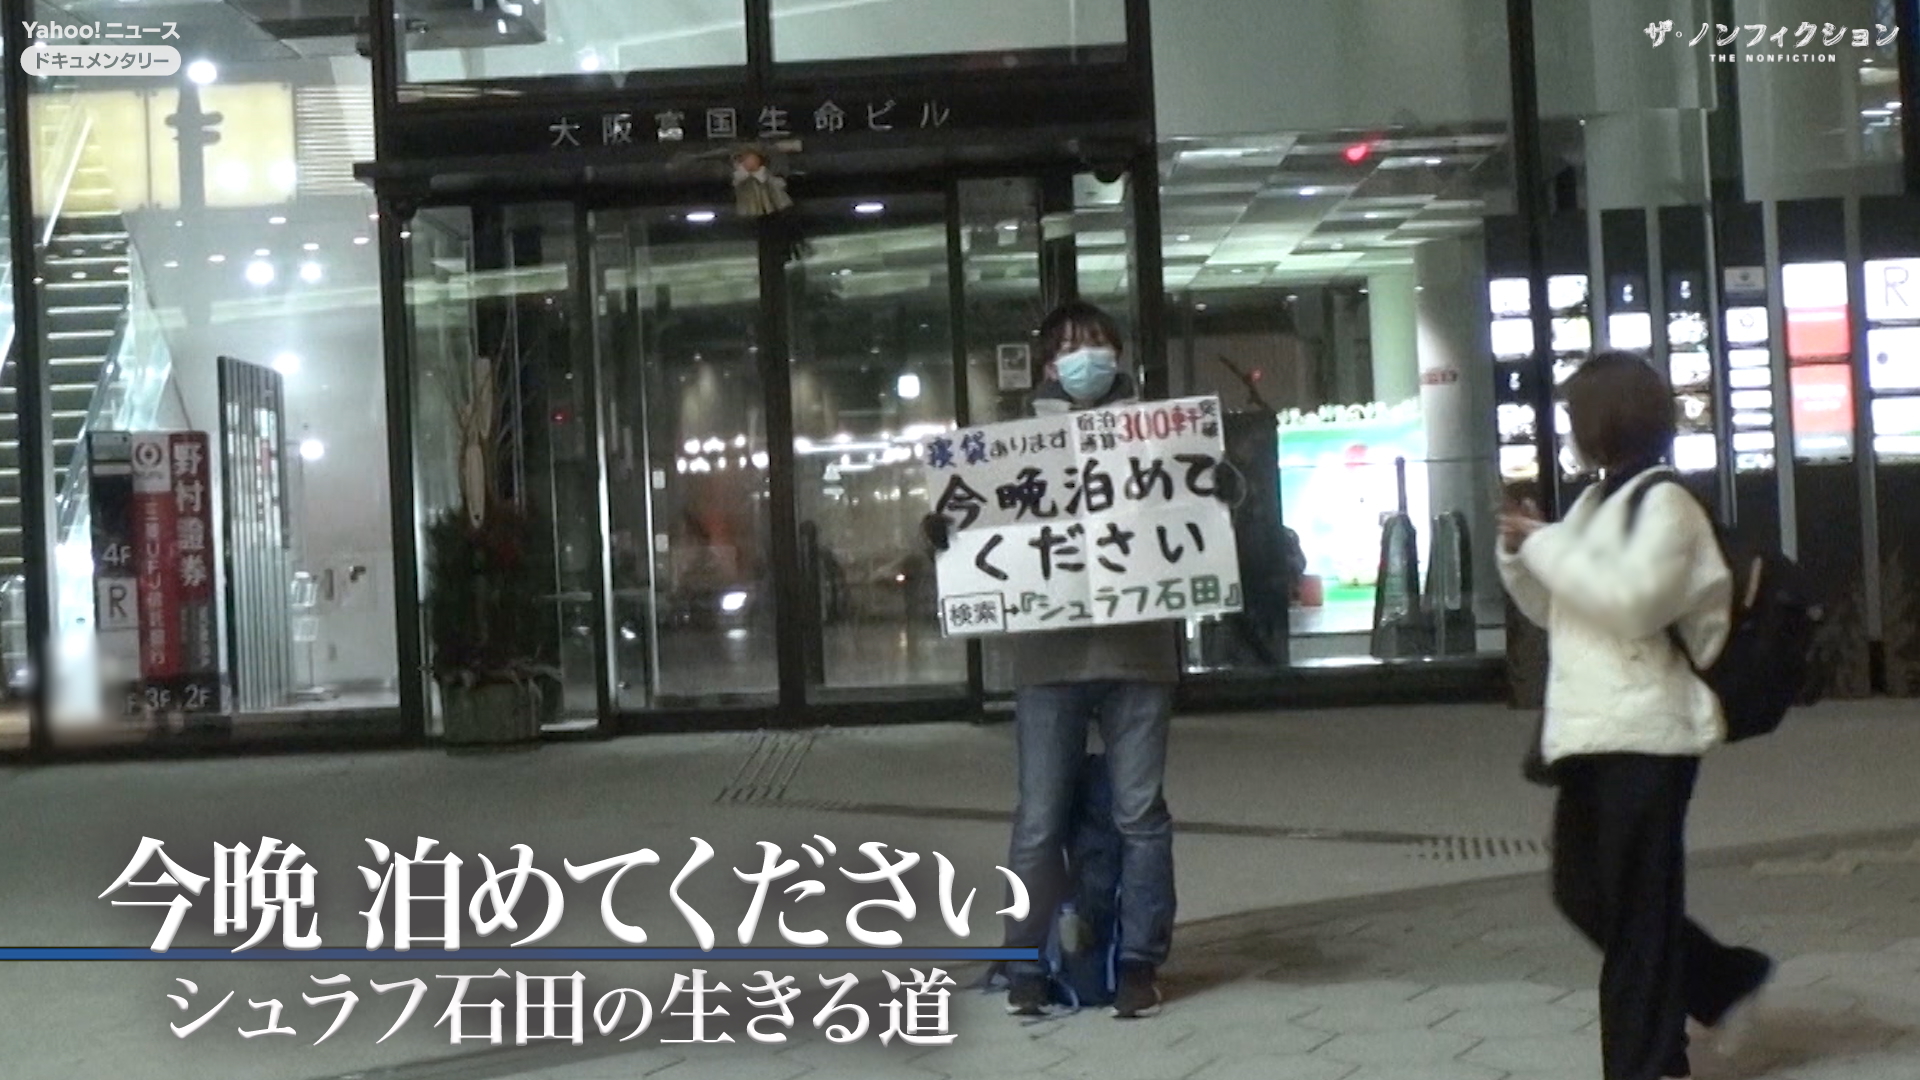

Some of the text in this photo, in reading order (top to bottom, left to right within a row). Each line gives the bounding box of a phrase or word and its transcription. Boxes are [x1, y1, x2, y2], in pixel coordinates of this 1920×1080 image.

[935, 453, 1216, 530] 今晩泊めて
[101, 543, 132, 565] 4F
[974, 522, 1206, 581] ください
[109, 585, 128, 618] R
[949, 600, 998, 627] 検索
[145, 687, 171, 711] 3F
[184, 684, 211, 708] 2F
